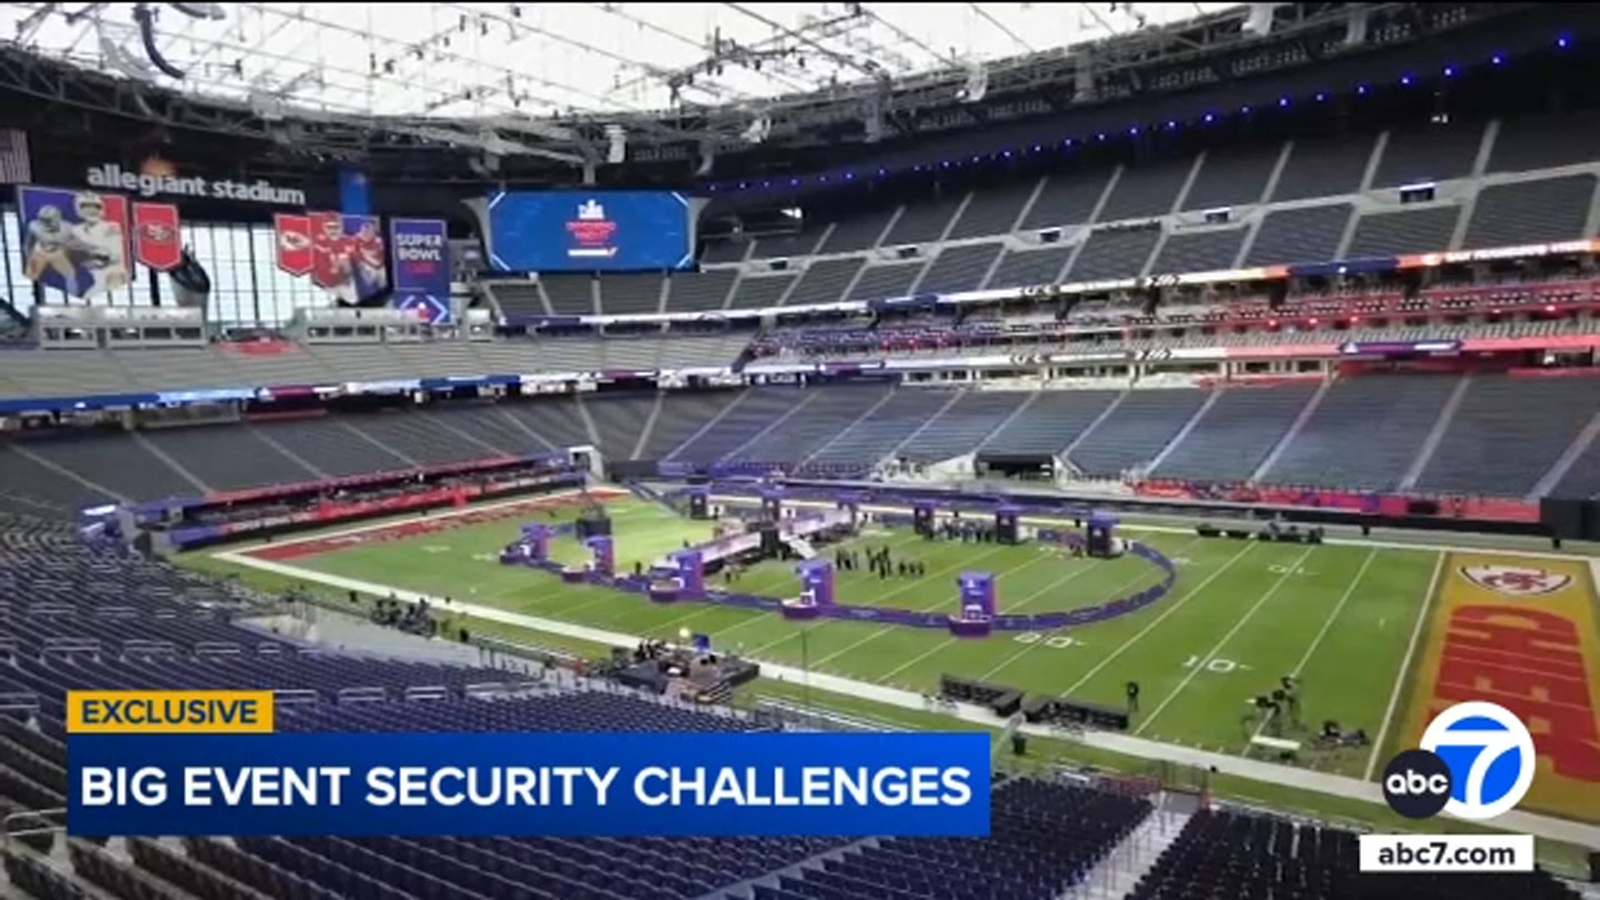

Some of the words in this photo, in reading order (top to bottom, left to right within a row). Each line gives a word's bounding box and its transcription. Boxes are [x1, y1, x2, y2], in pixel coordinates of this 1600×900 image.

[87, 163, 206, 196] allegiant
[212, 179, 305, 205] stadium
[396, 233, 441, 247] SUPER
[398, 247, 441, 261] BOWL
